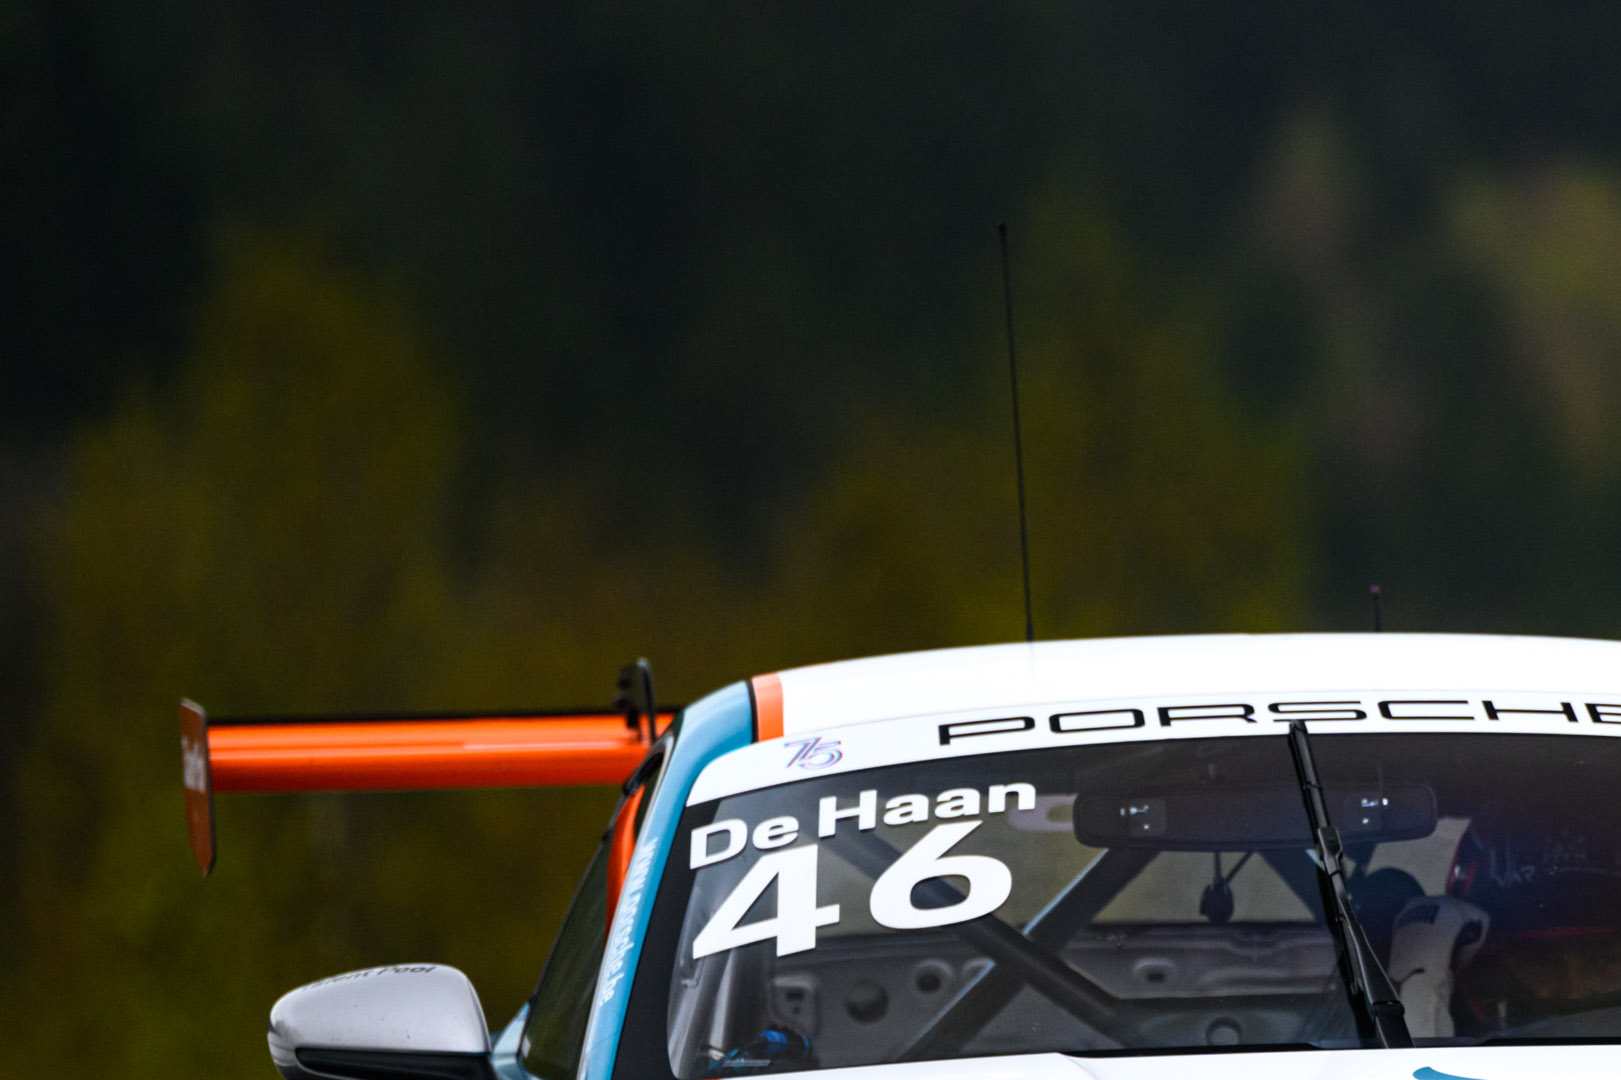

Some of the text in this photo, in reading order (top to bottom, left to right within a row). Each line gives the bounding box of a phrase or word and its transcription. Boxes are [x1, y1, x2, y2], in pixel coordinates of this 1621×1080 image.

[784, 736, 843, 770] 75
[690, 782, 1036, 870] De Haan
[692, 820, 1012, 960] 46
